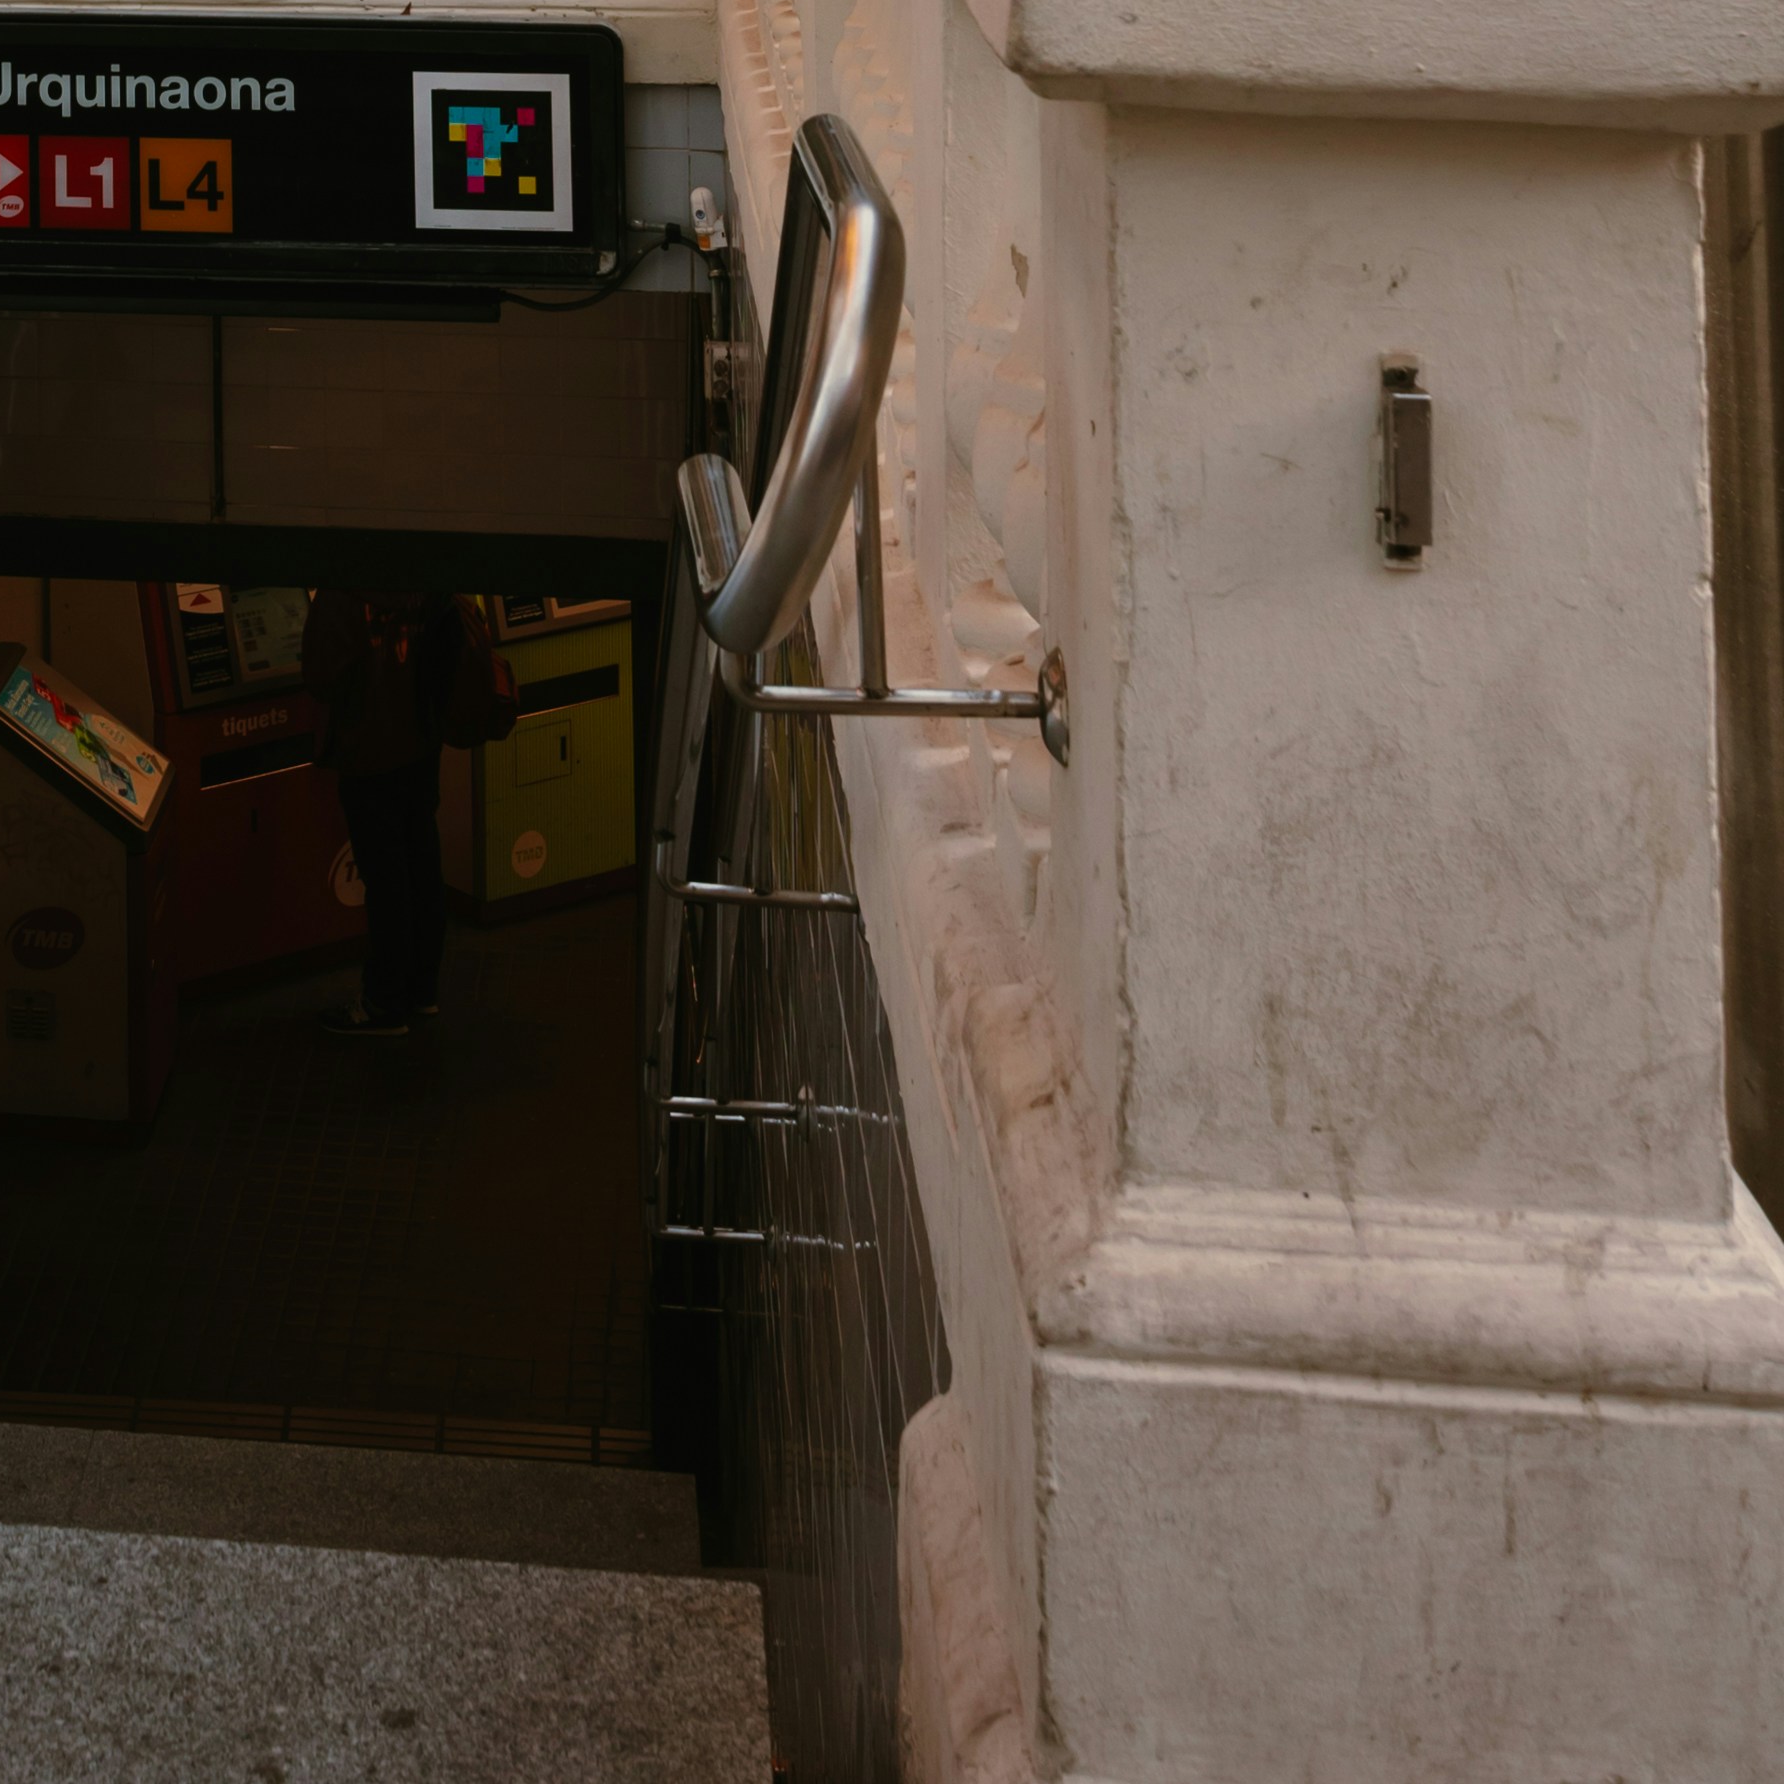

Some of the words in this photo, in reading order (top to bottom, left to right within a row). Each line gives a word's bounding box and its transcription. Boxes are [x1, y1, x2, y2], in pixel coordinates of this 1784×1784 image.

[54, 154, 115, 209] L1
[148, 158, 224, 211] L4
[220, 707, 289, 737] tiquets
[514, 845, 545, 865] TMB
[19, 927, 76, 950] TMB
